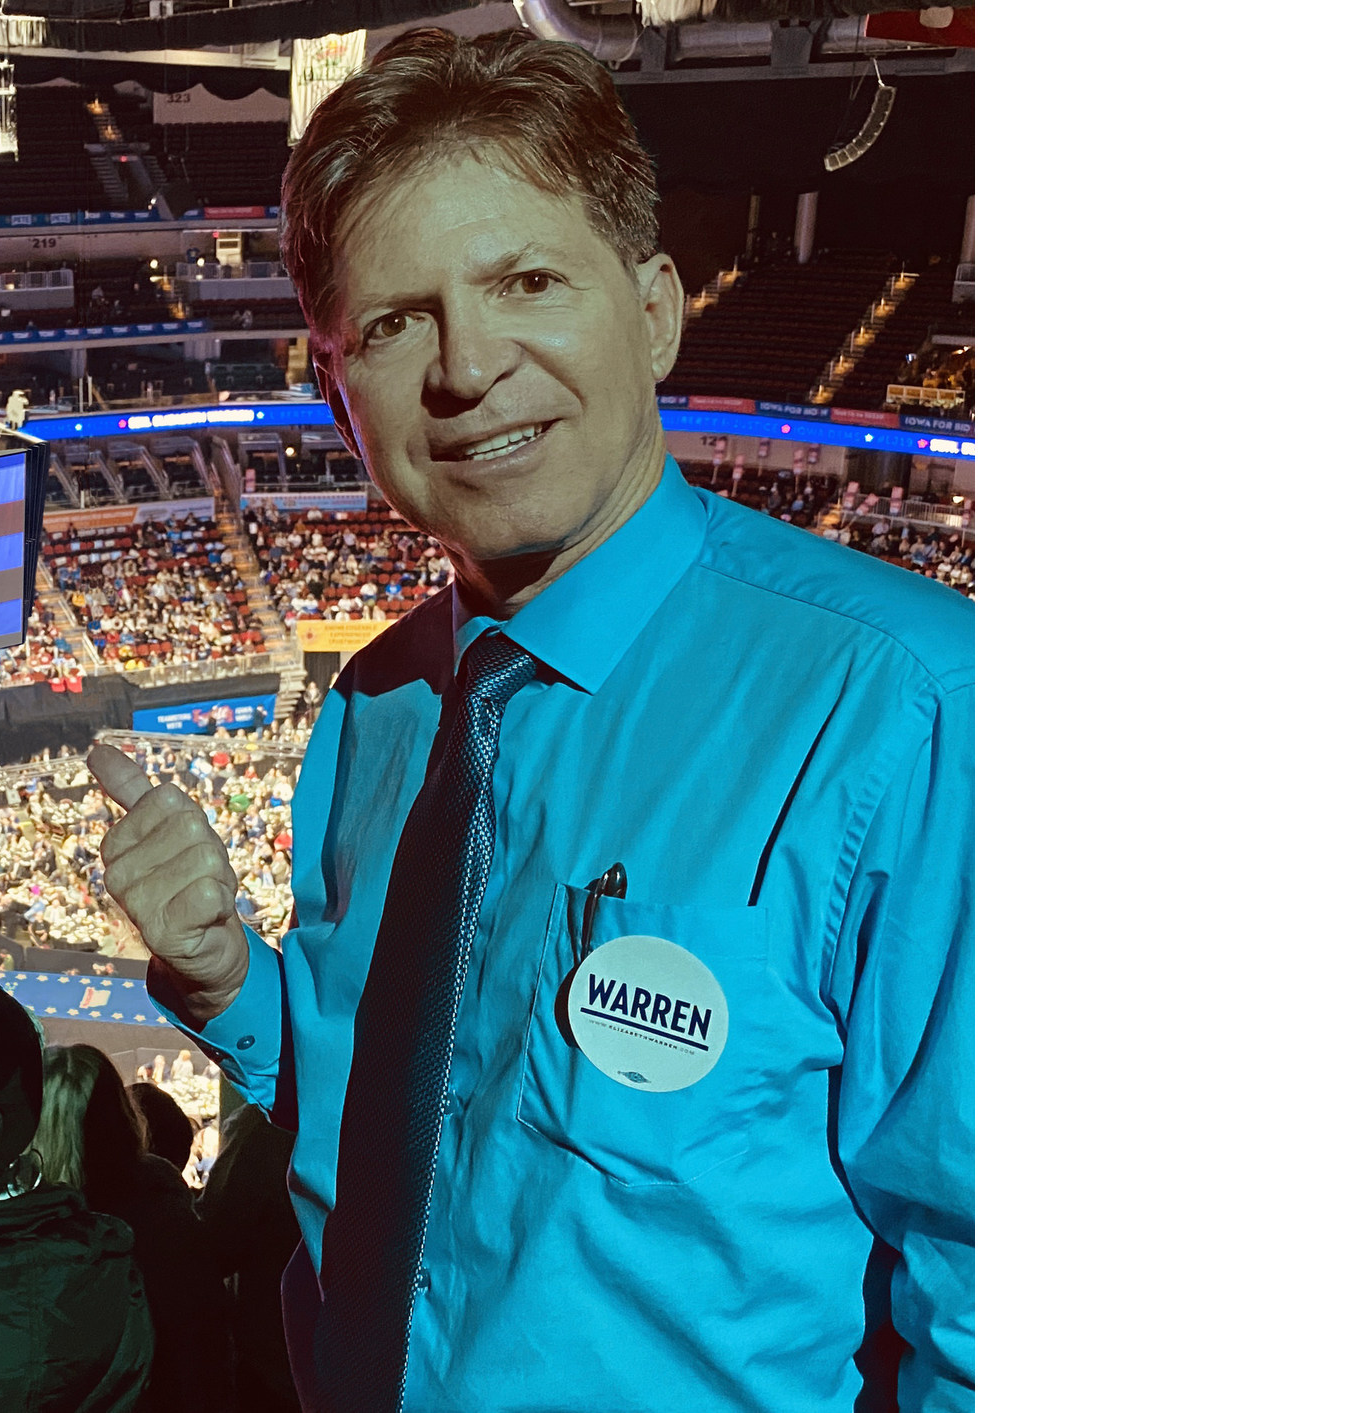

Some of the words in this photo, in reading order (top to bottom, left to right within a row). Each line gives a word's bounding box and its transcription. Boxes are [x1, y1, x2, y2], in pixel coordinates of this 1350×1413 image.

[32, 238, 57, 249] 219
[904, 416, 931, 428] IOWA
[932, 418, 953, 430] FOR
[588, 973, 712, 1041] WARREN
